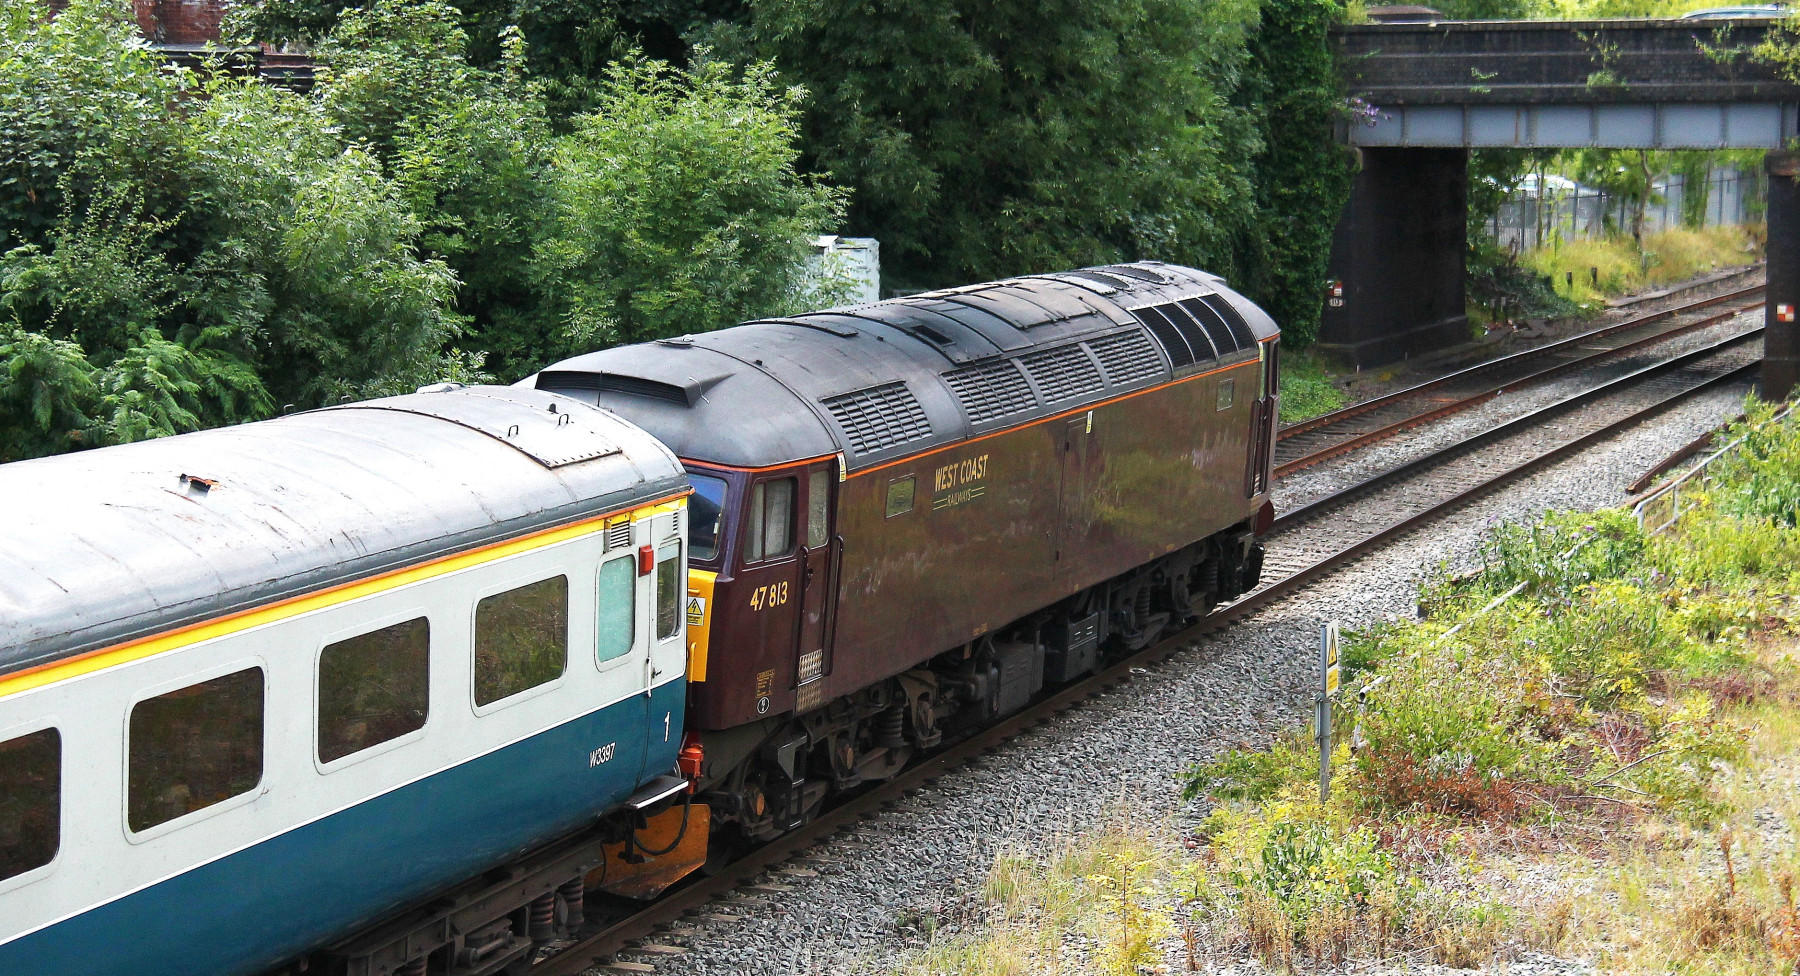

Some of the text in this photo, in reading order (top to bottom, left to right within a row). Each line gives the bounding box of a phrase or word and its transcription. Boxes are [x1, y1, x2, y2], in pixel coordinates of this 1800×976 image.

[935, 454, 989, 492] WEST COAST
[750, 581, 788, 611] 47 813
[664, 711, 671, 742] 1
[589, 742, 616, 768] W3397
